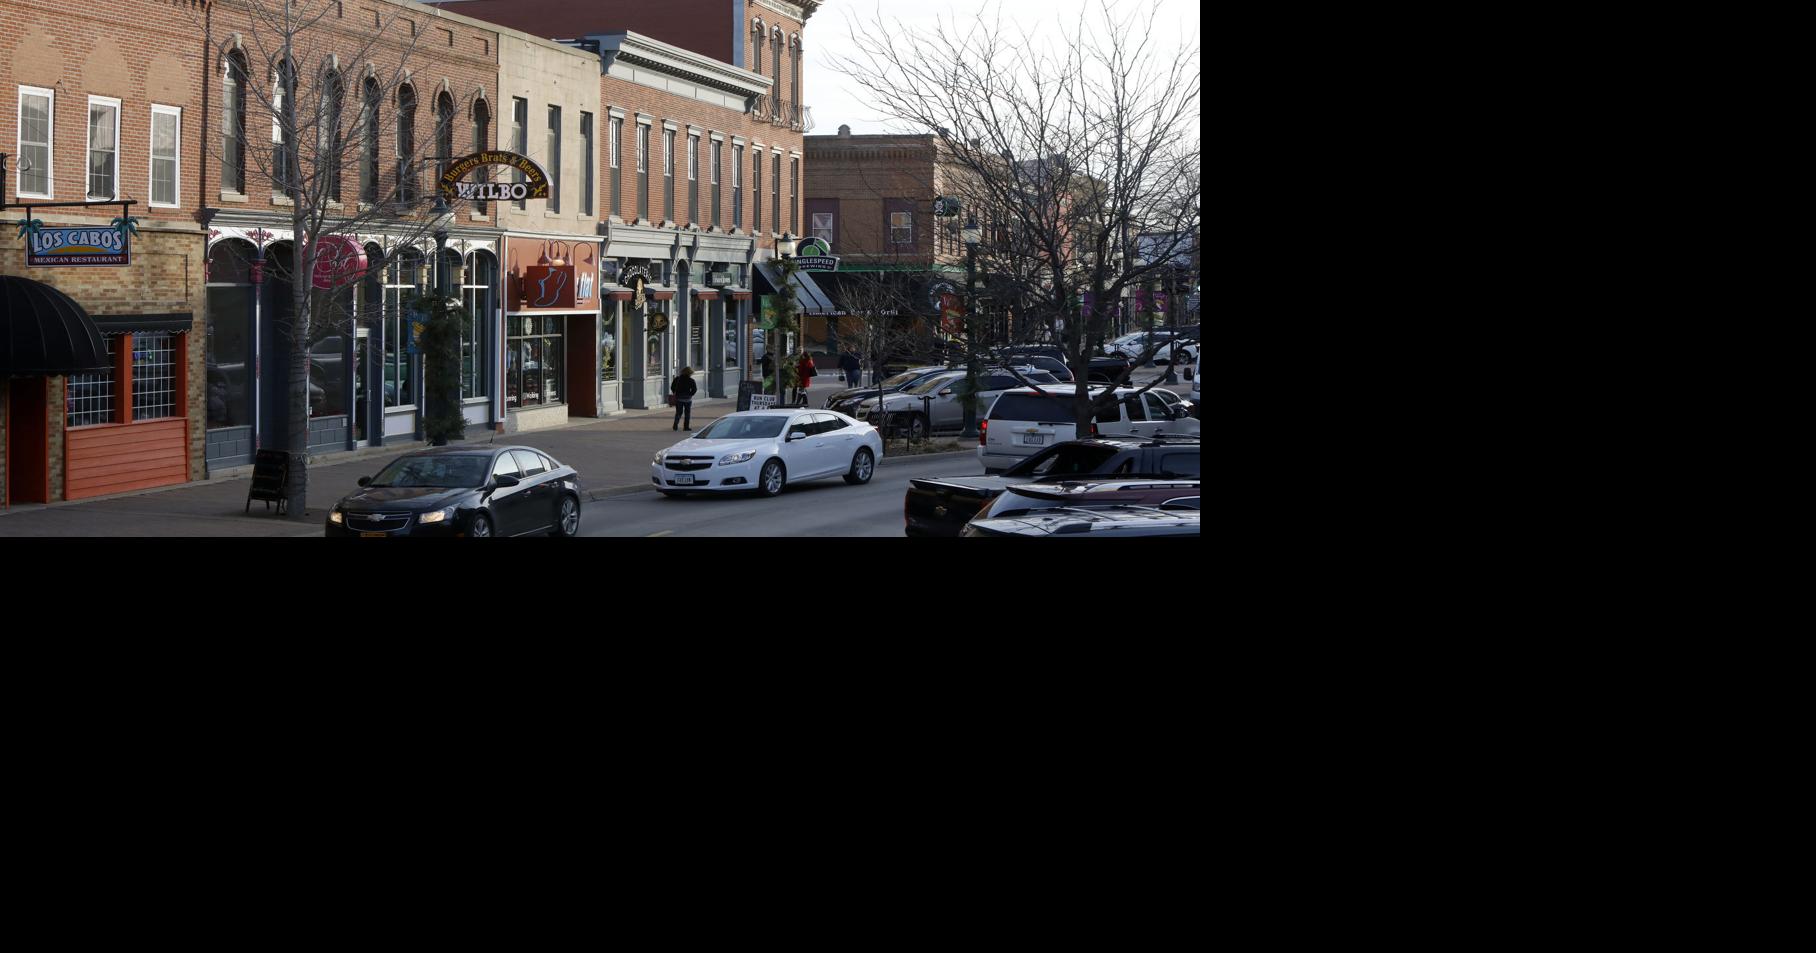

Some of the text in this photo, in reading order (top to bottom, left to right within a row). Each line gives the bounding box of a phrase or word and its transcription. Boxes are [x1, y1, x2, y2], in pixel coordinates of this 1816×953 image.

[444, 157, 479, 181] Burgers
[481, 152, 508, 164] Brats
[519, 159, 541, 182] Beers
[456, 182, 527, 199] WILBO
[33, 231, 122, 253] LOS CABOS
